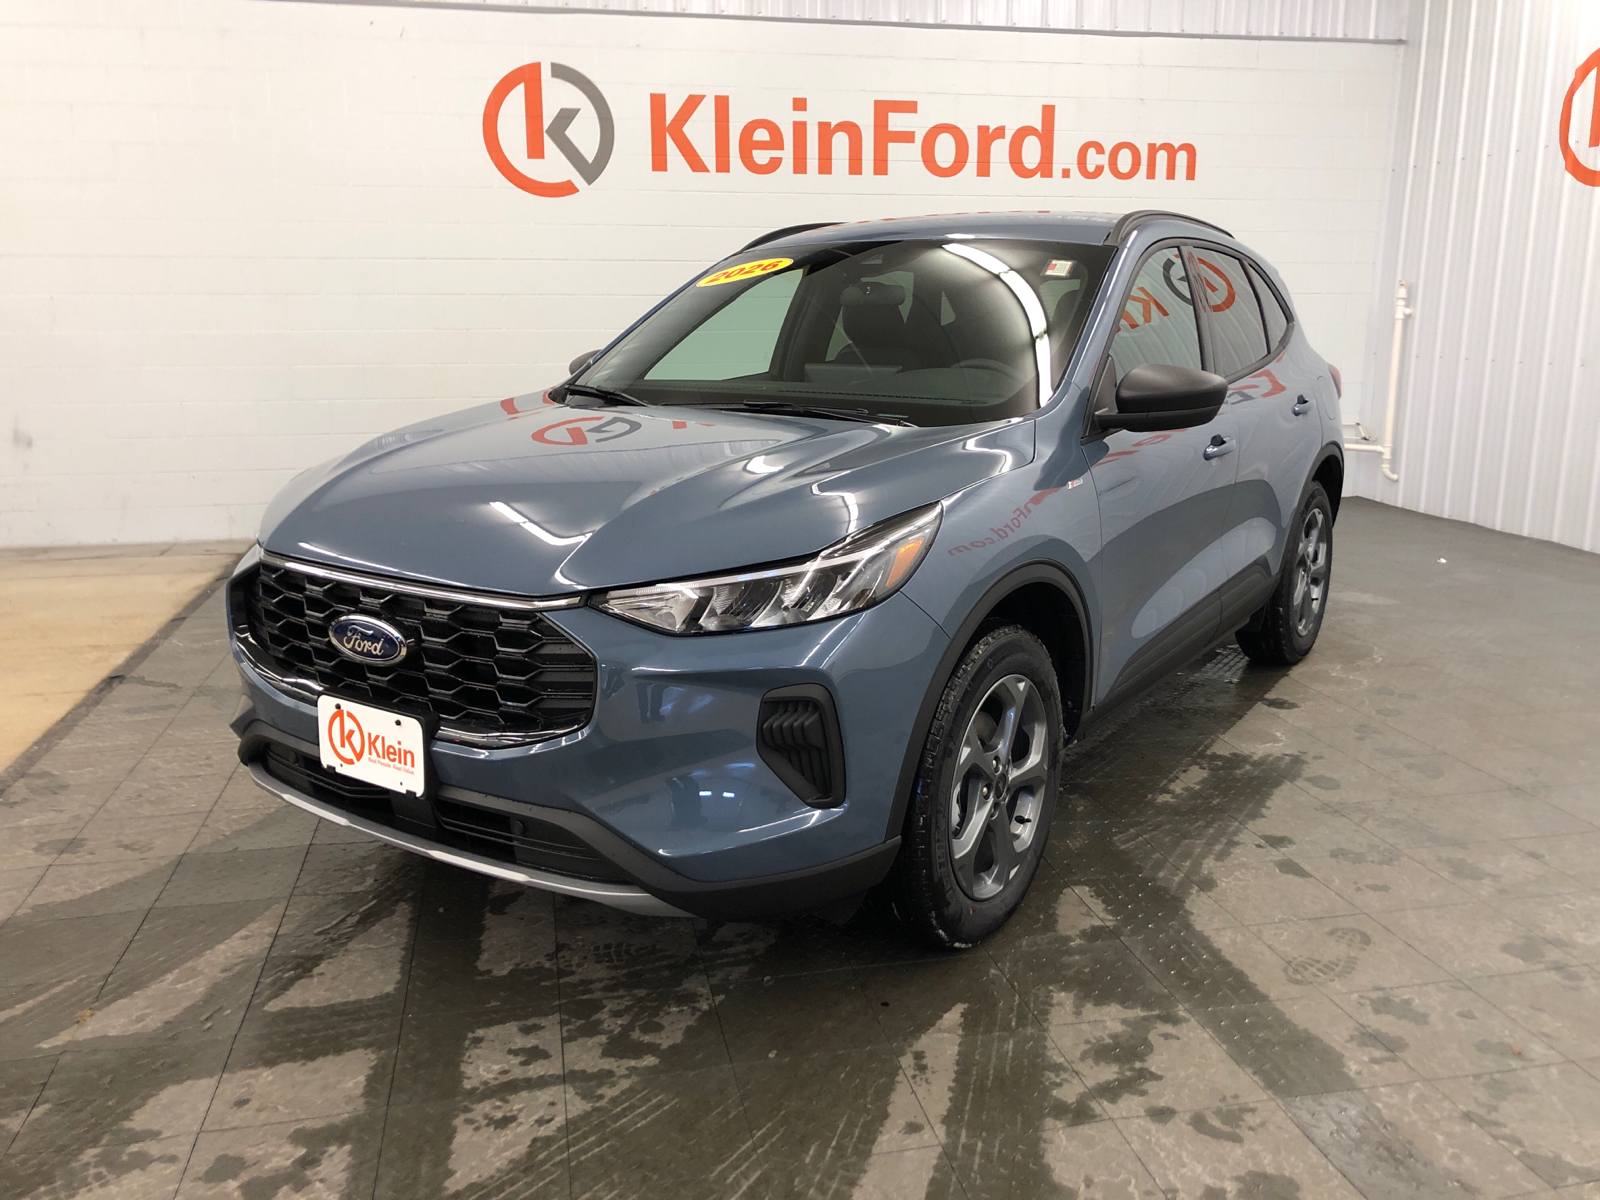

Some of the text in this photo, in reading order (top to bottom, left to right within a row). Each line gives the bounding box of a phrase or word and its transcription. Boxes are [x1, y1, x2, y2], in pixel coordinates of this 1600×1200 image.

[650, 92, 1197, 181] KleinFord.com
[704, 260, 784, 284] 2026
[343, 624, 384, 656] Ford
[367, 732, 415, 768] Klein
